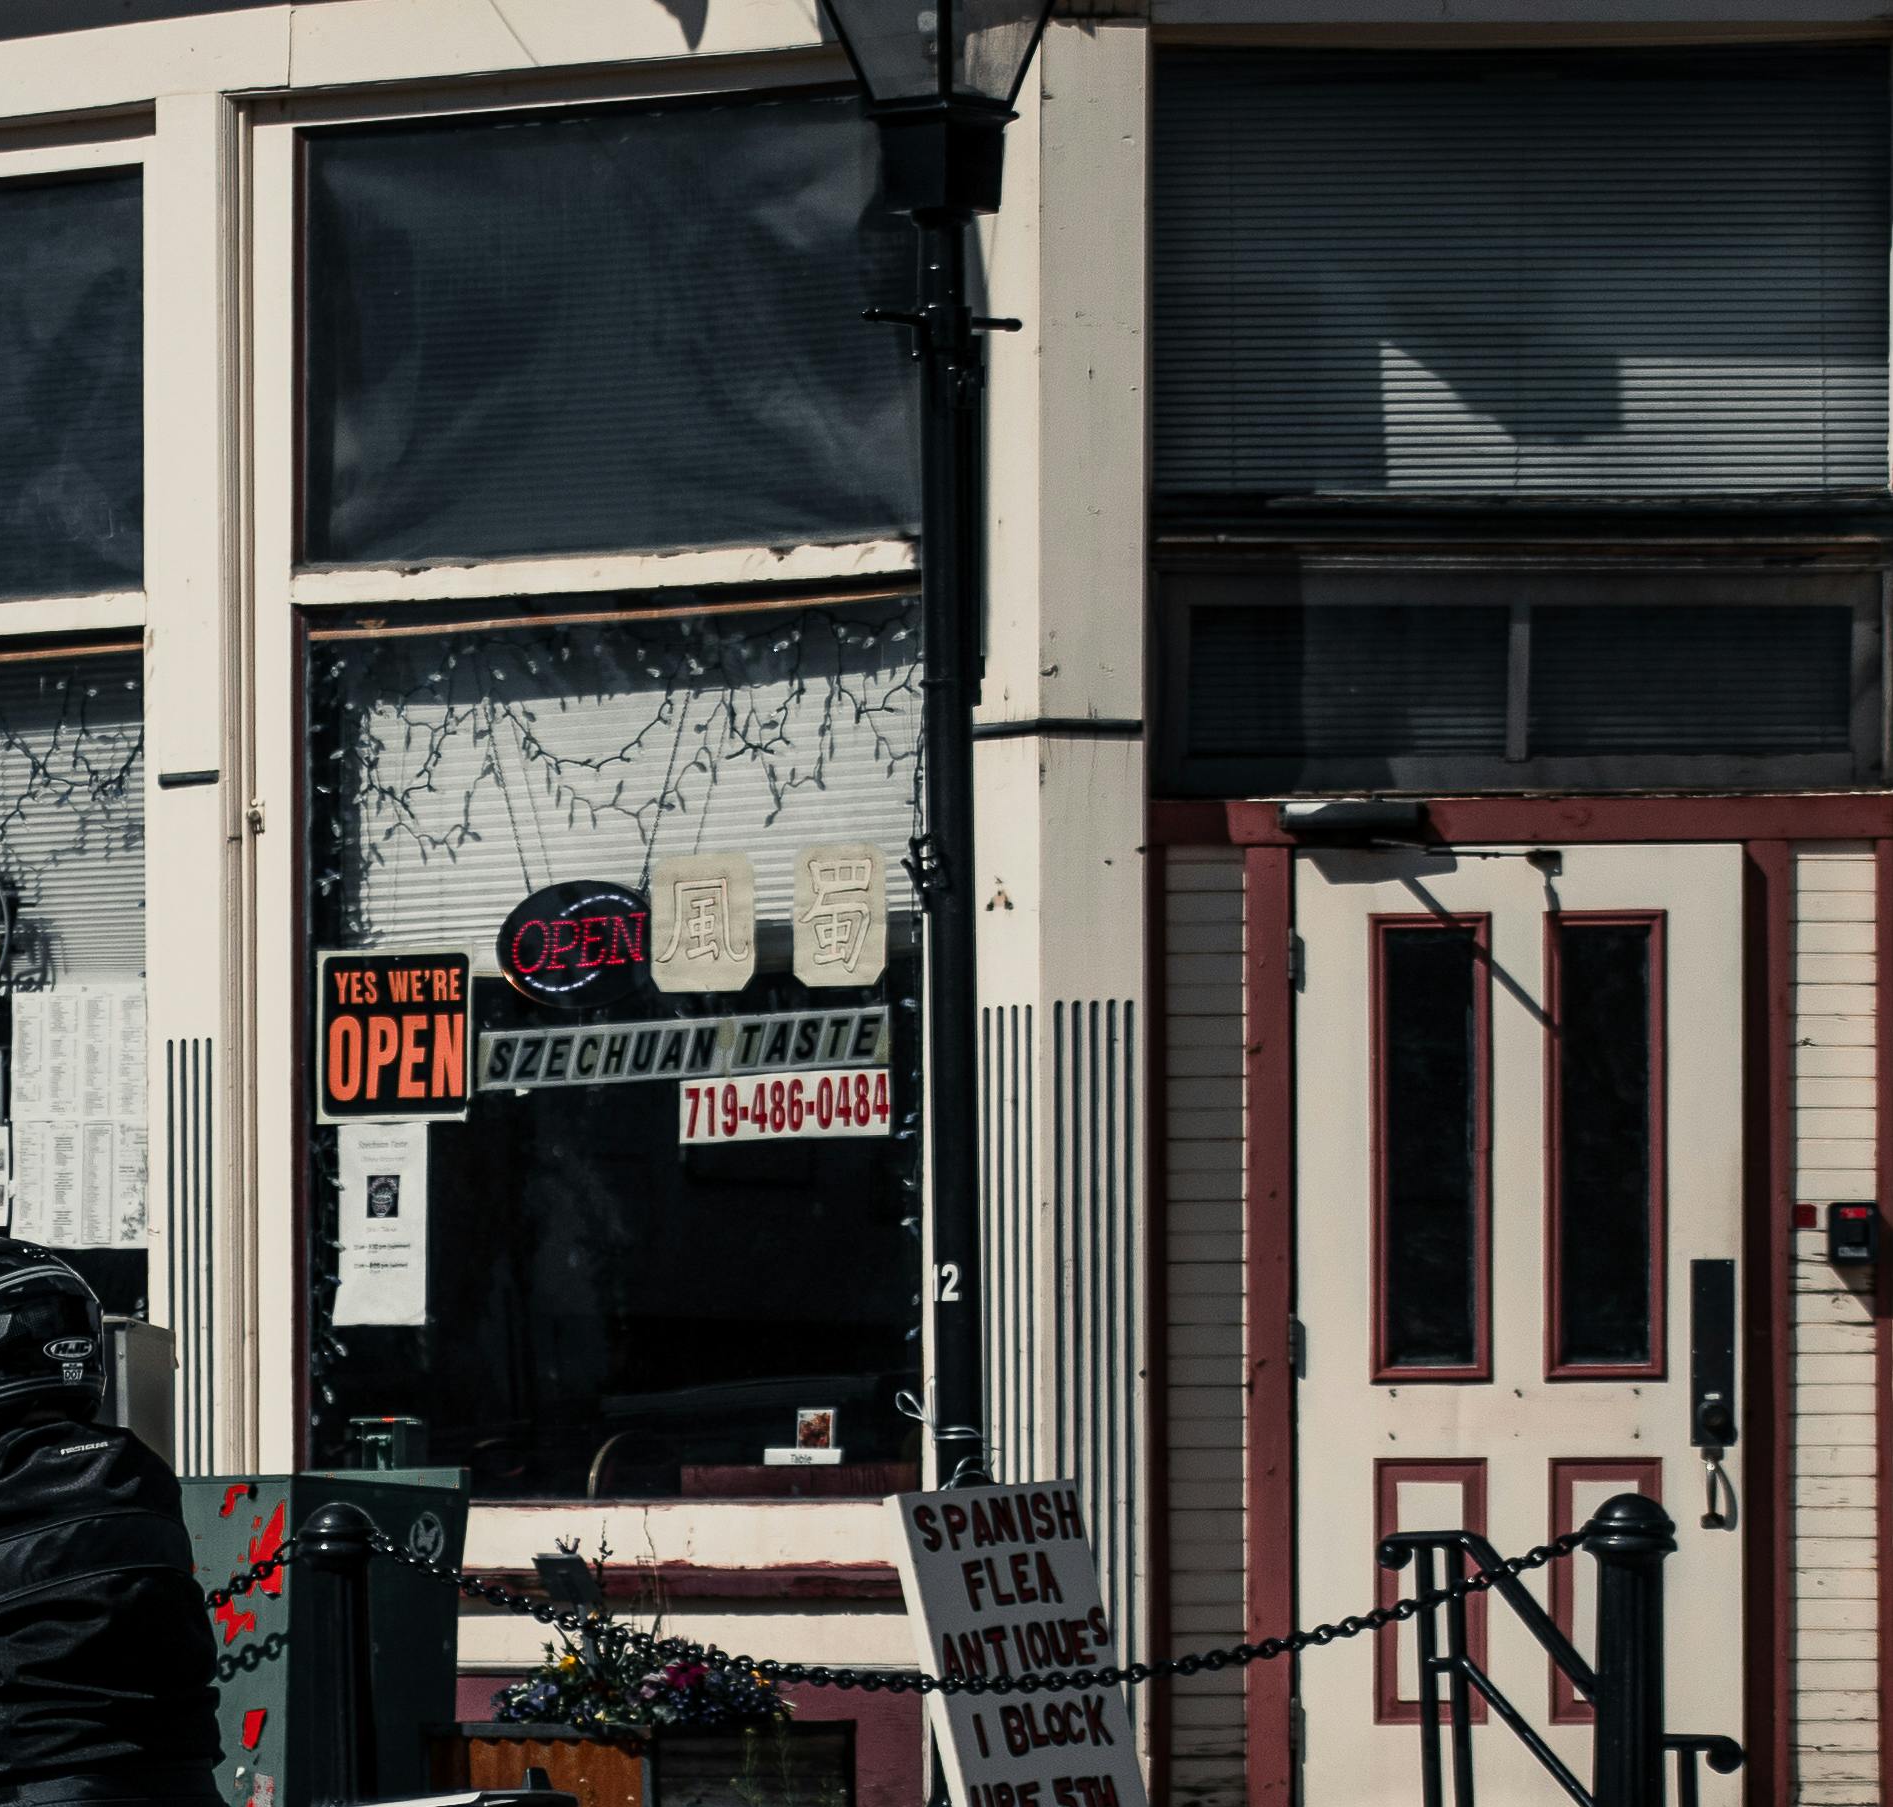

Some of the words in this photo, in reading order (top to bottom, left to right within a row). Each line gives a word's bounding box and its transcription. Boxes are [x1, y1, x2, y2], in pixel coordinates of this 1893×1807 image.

[512, 911, 648, 975] OPEN
[335, 971, 377, 1003] YES
[387, 968, 461, 1002] WE'RE
[328, 1014, 464, 1101] OPEN
[488, 1030, 719, 1078] SZECHUAN
[729, 1013, 883, 1065] TASTE
[684, 1073, 890, 1140] 719-486-0484
[913, 1490, 1083, 1552] SPANISH
[961, 1552, 1063, 1611] FLEA
[941, 1606, 1108, 1680] ANTIQUES
[999, 1694, 1114, 1757] BLOCK
